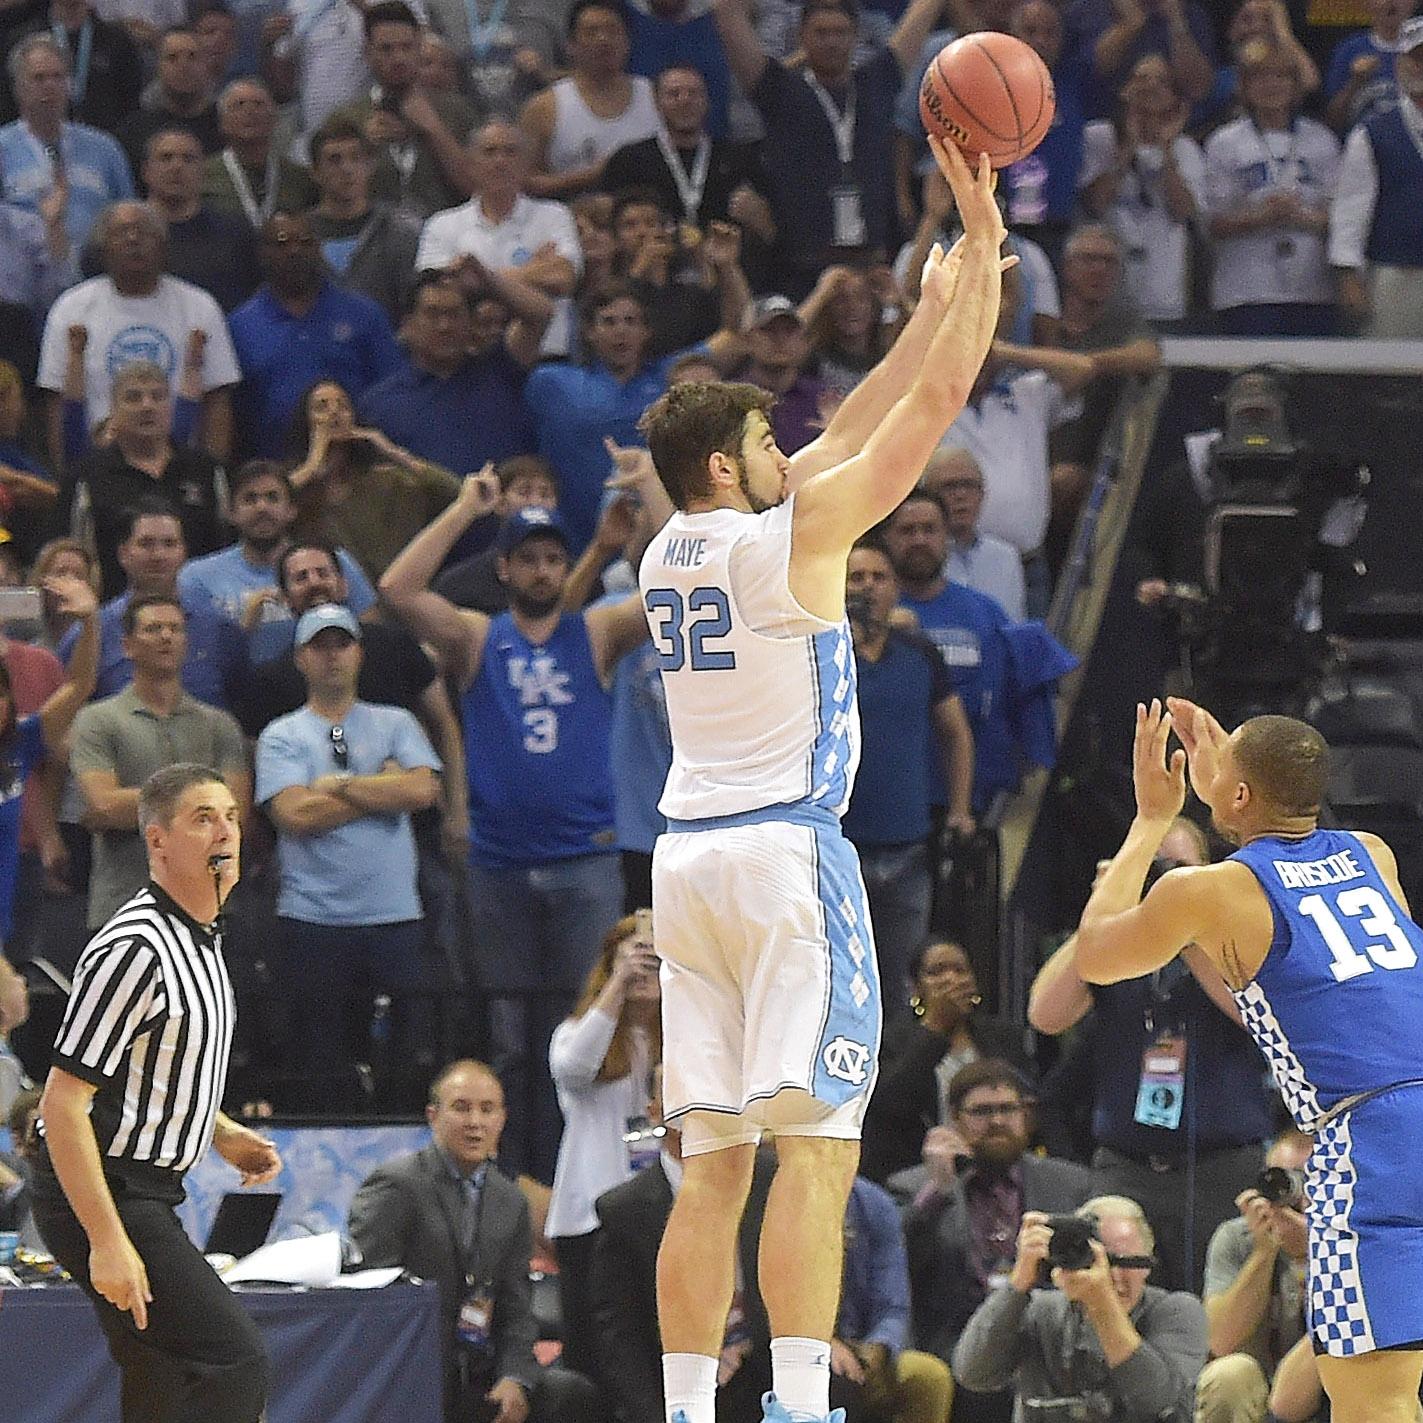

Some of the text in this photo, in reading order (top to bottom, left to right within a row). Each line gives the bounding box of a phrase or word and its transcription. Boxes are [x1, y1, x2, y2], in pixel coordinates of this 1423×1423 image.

[662, 538, 707, 567] MAYE
[645, 586, 736, 672] 32
[523, 708, 558, 753] 3
[1272, 849, 1366, 889] BRISCOE
[1298, 886, 1418, 982] 13
